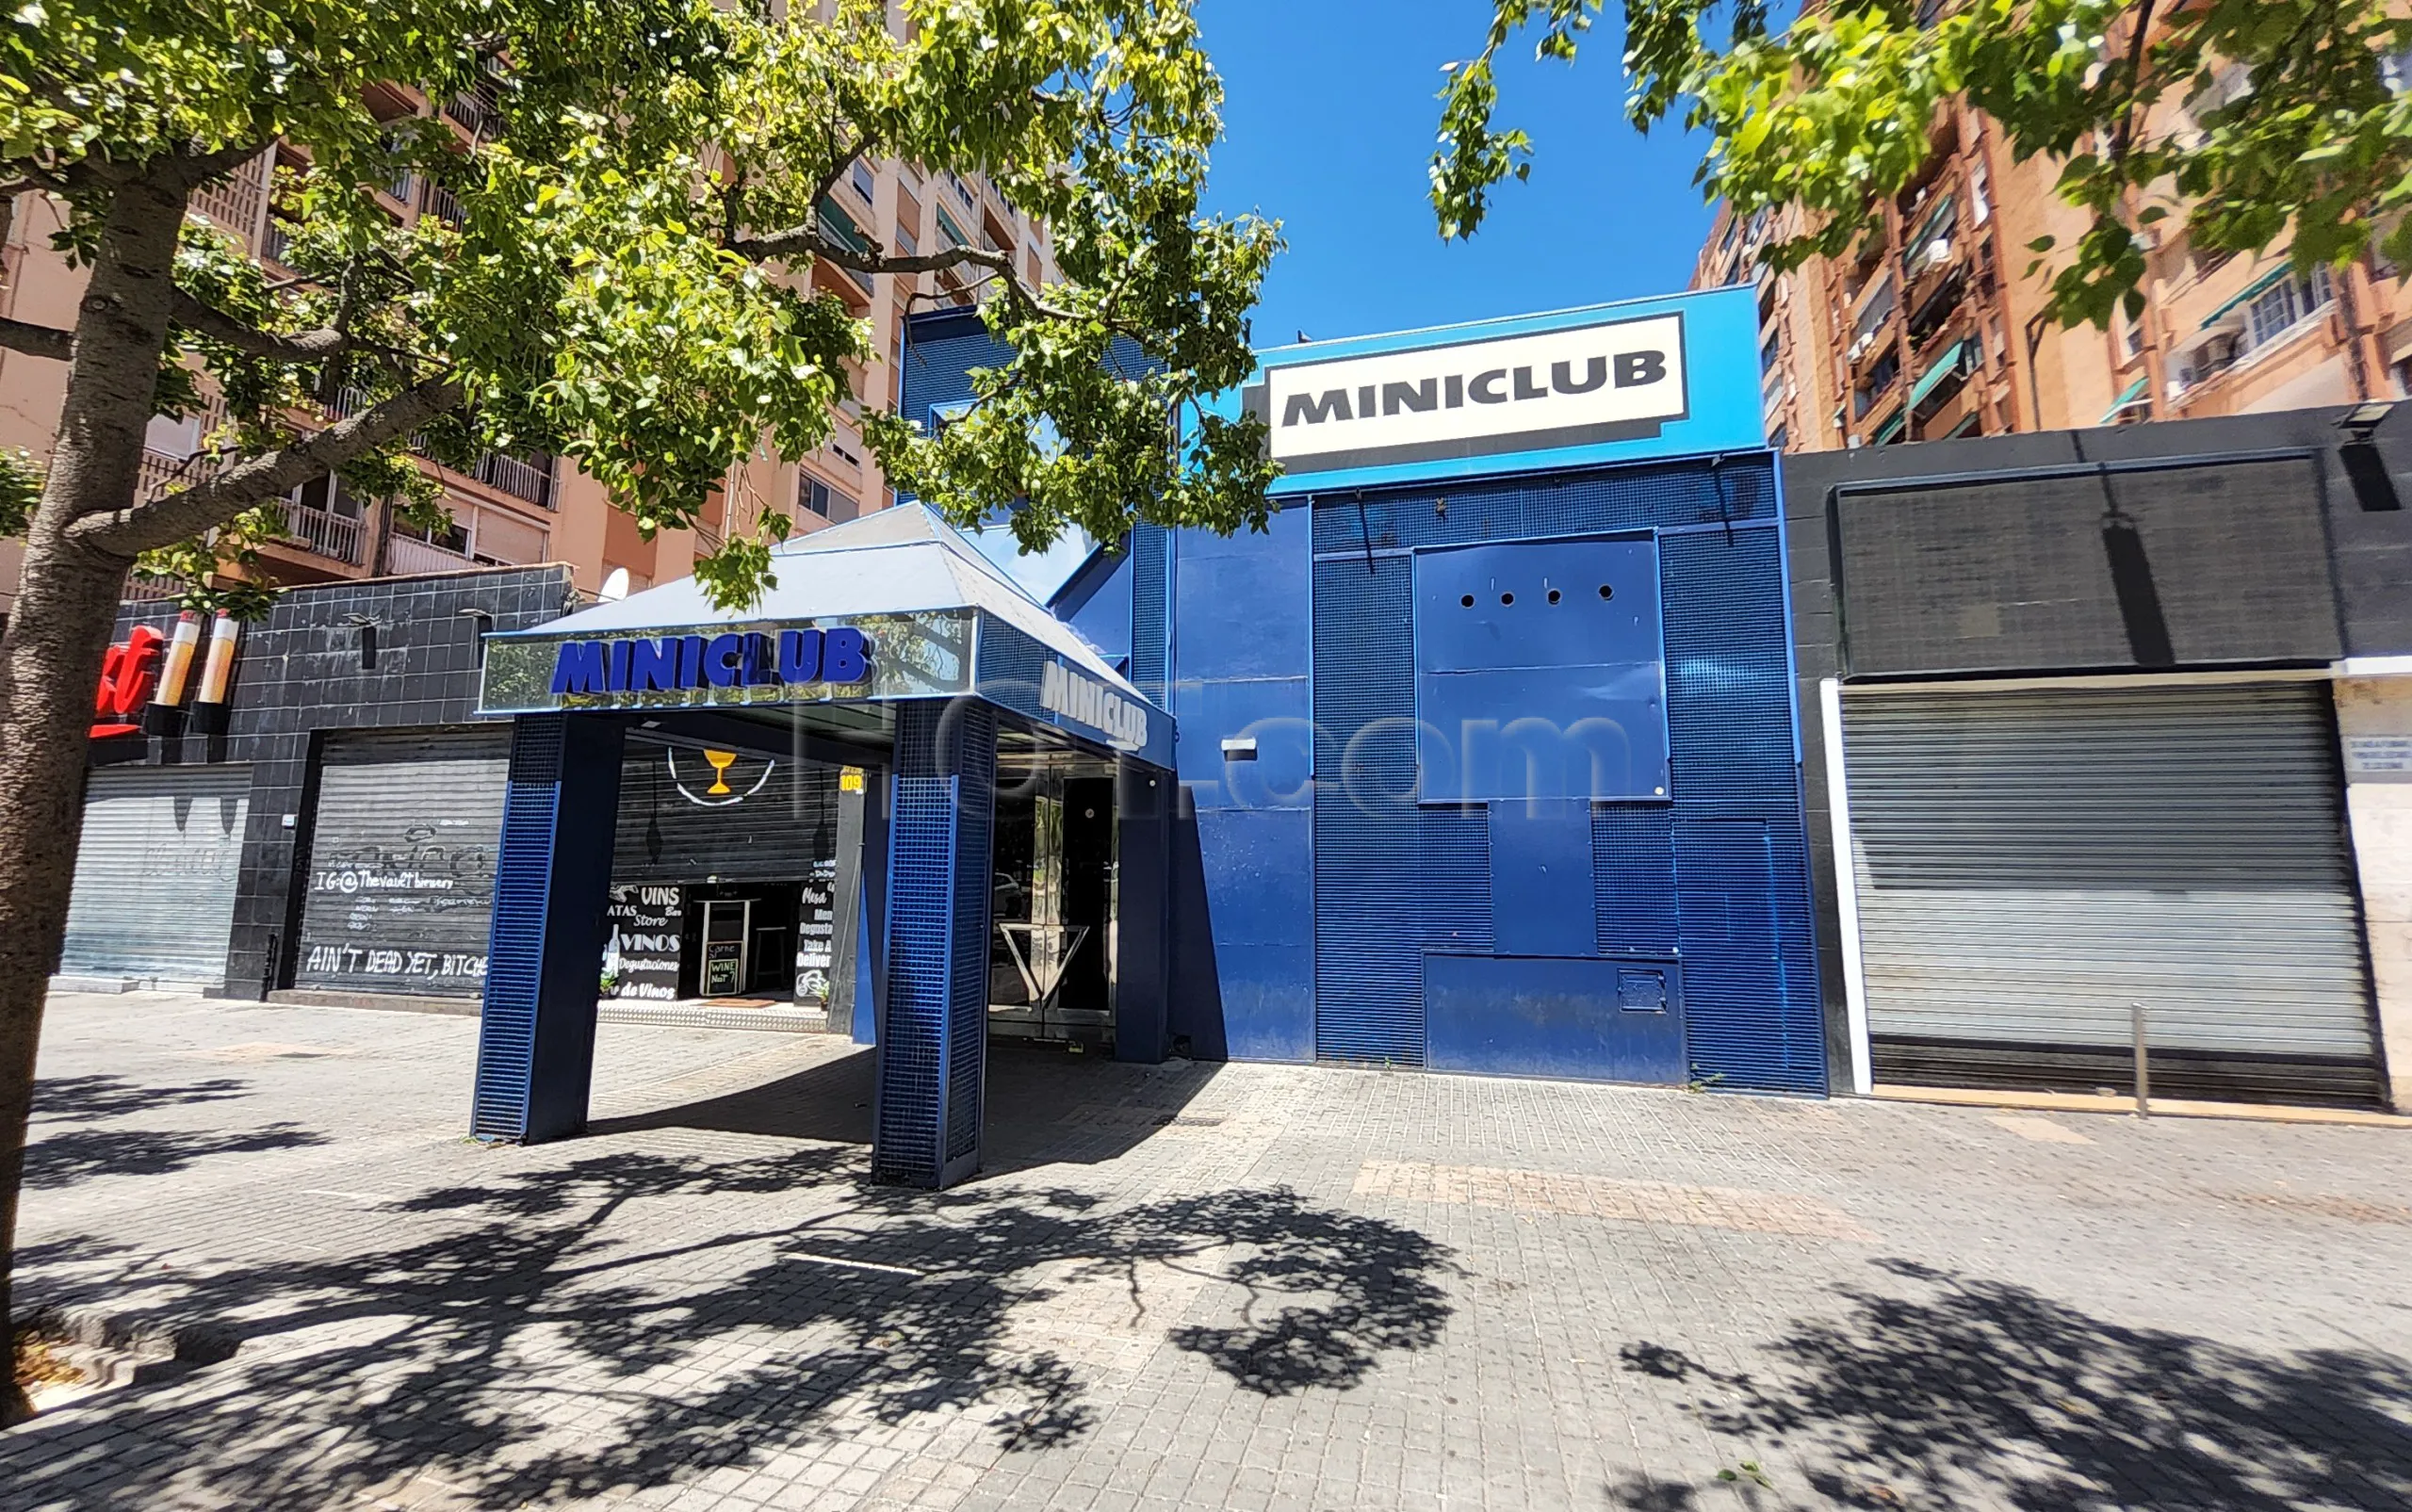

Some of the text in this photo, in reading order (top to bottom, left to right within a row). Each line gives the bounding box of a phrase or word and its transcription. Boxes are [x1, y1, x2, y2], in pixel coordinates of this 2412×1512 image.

[1282, 350, 1667, 428] MINICLUB
[551, 627, 874, 694] MINICLUB
[1040, 660, 1148, 746] MINICLUB
[841, 774, 862, 791] 109
[642, 887, 679, 905] VINS
[633, 915, 668, 927] Store
[621, 934, 680, 952] VINOS
[306, 943, 363, 973] AIN'T
[365, 950, 402, 974] DEAD
[711, 962, 735, 972] WINE
[621, 982, 637, 997] de
[639, 984, 676, 1000] Vinos
